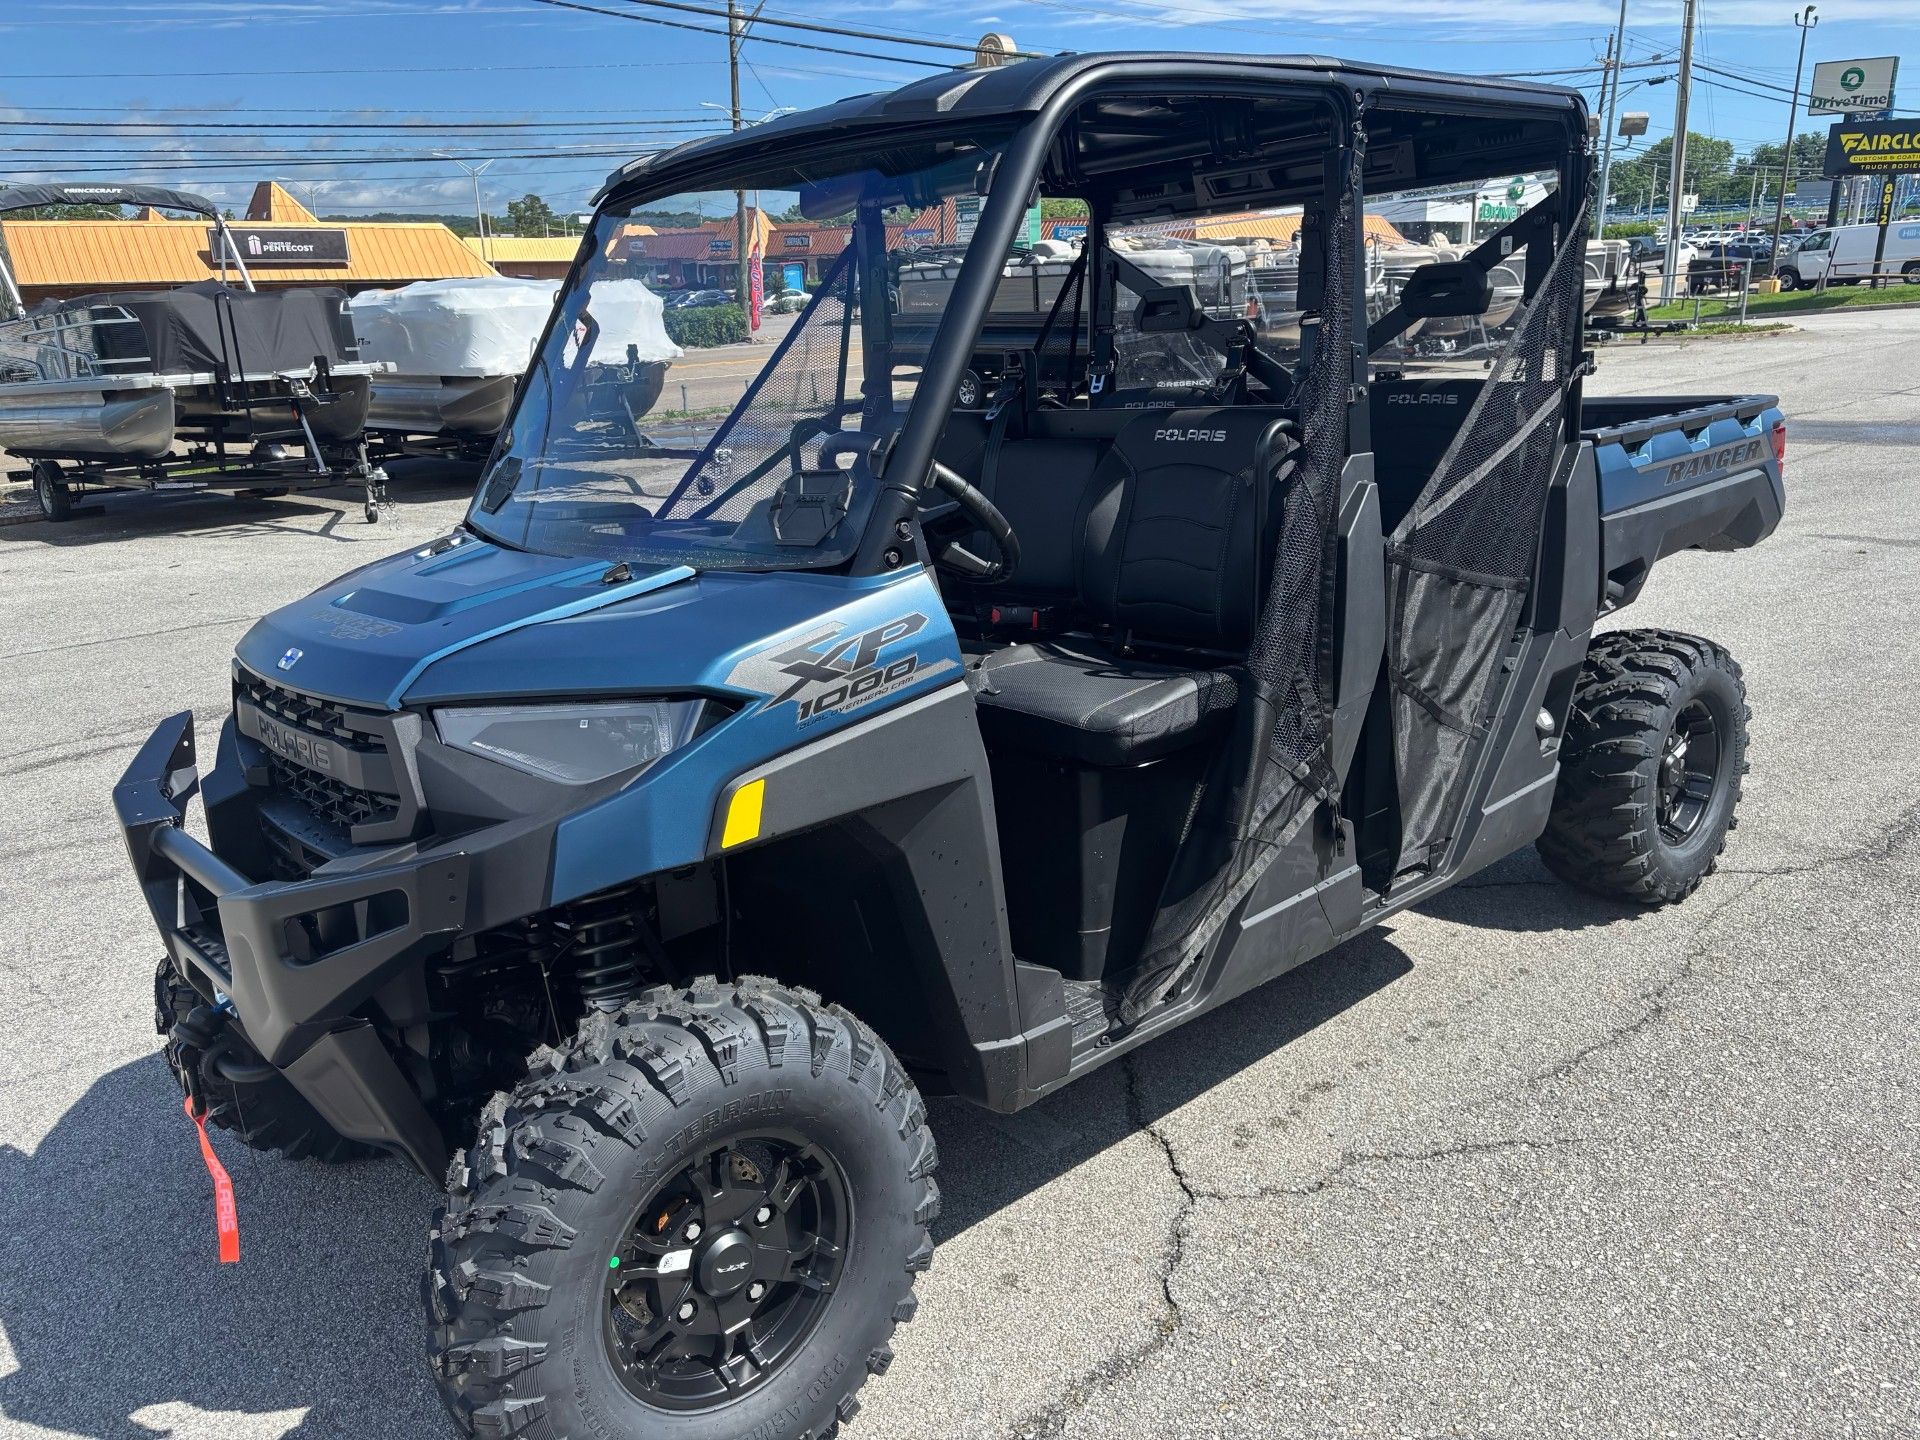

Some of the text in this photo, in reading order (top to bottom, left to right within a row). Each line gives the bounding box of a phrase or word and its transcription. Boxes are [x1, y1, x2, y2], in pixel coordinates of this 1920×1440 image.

[1811, 95, 1887, 109] DriveTime
[1880, 183, 1893, 224] 8812
[263, 244, 314, 252] PENTECOST
[1166, 379, 1212, 388] REGENCY
[1387, 393, 1459, 405] POLARIS
[1154, 428, 1227, 442] POLARIS
[1664, 440, 1761, 486] RANGER
[757, 612, 929, 714] XP
[798, 654, 919, 722] 1000
[799, 675, 915, 731] DUAL OVERHEAD CAM
[257, 713, 331, 768] POLARIS
[632, 1088, 792, 1188] X-TERRAIN
[209, 1158, 236, 1233] POLARIS
